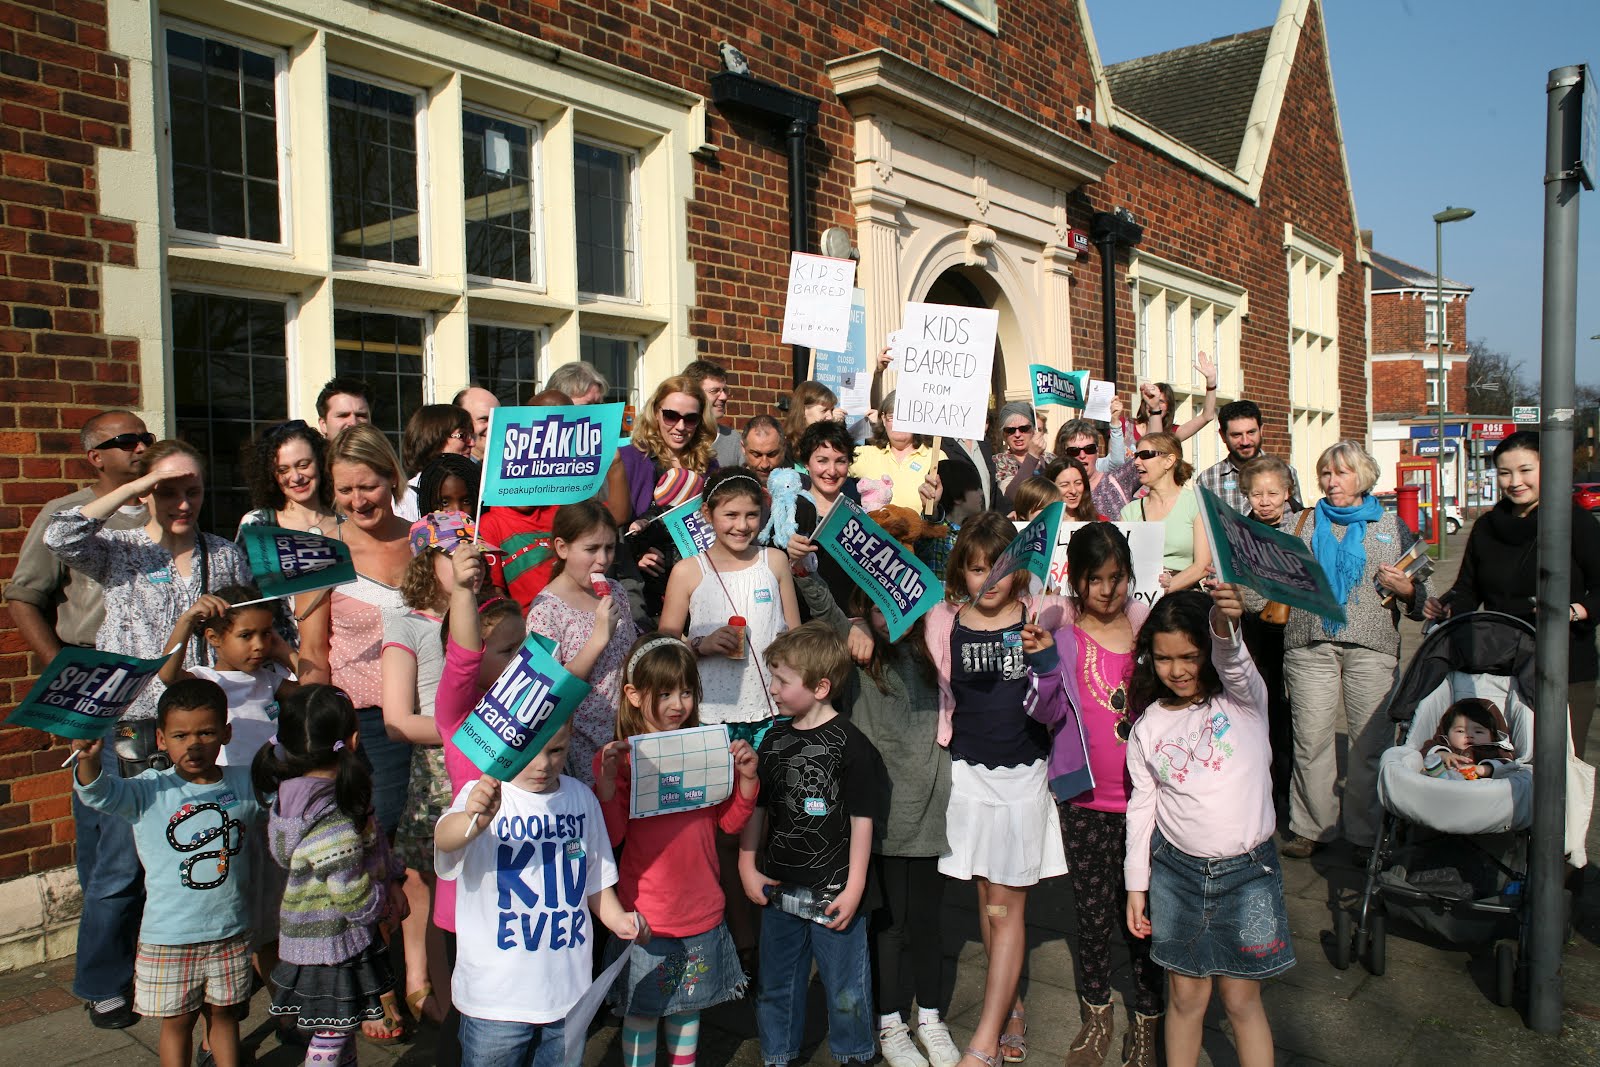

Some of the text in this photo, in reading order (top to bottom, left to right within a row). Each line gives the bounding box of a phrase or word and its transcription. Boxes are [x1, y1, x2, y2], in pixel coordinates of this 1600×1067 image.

[795, 260, 844, 281] KIDS
[793, 284, 845, 296] BARRED
[791, 323, 840, 334] LIBRARY
[849, 310, 864, 324] NET
[923, 315, 970, 344] KIDS
[816, 362, 829, 371] ESDAY
[837, 355, 855, 365] CLOSED
[904, 347, 977, 378] BARRED
[922, 382, 951, 395] FROM
[896, 399, 971, 427] LIBRARY
[1482, 424, 1503, 432] ROSE
[506, 459, 595, 477] for libraries
[498, 482, 594, 497] speakupforlibraries.org
[830, 543, 898, 624] speakupforlibraries.org
[840, 536, 859, 557] for
[859, 557, 907, 610] libraries
[43, 692, 71, 707] for
[516, 680, 555, 730] UP
[475, 697, 526, 747] raries
[461, 721, 513, 769] rlibraries.org
[497, 813, 586, 841] COOLEST
[496, 841, 587, 909] KID
[496, 909, 586, 951] EVER
